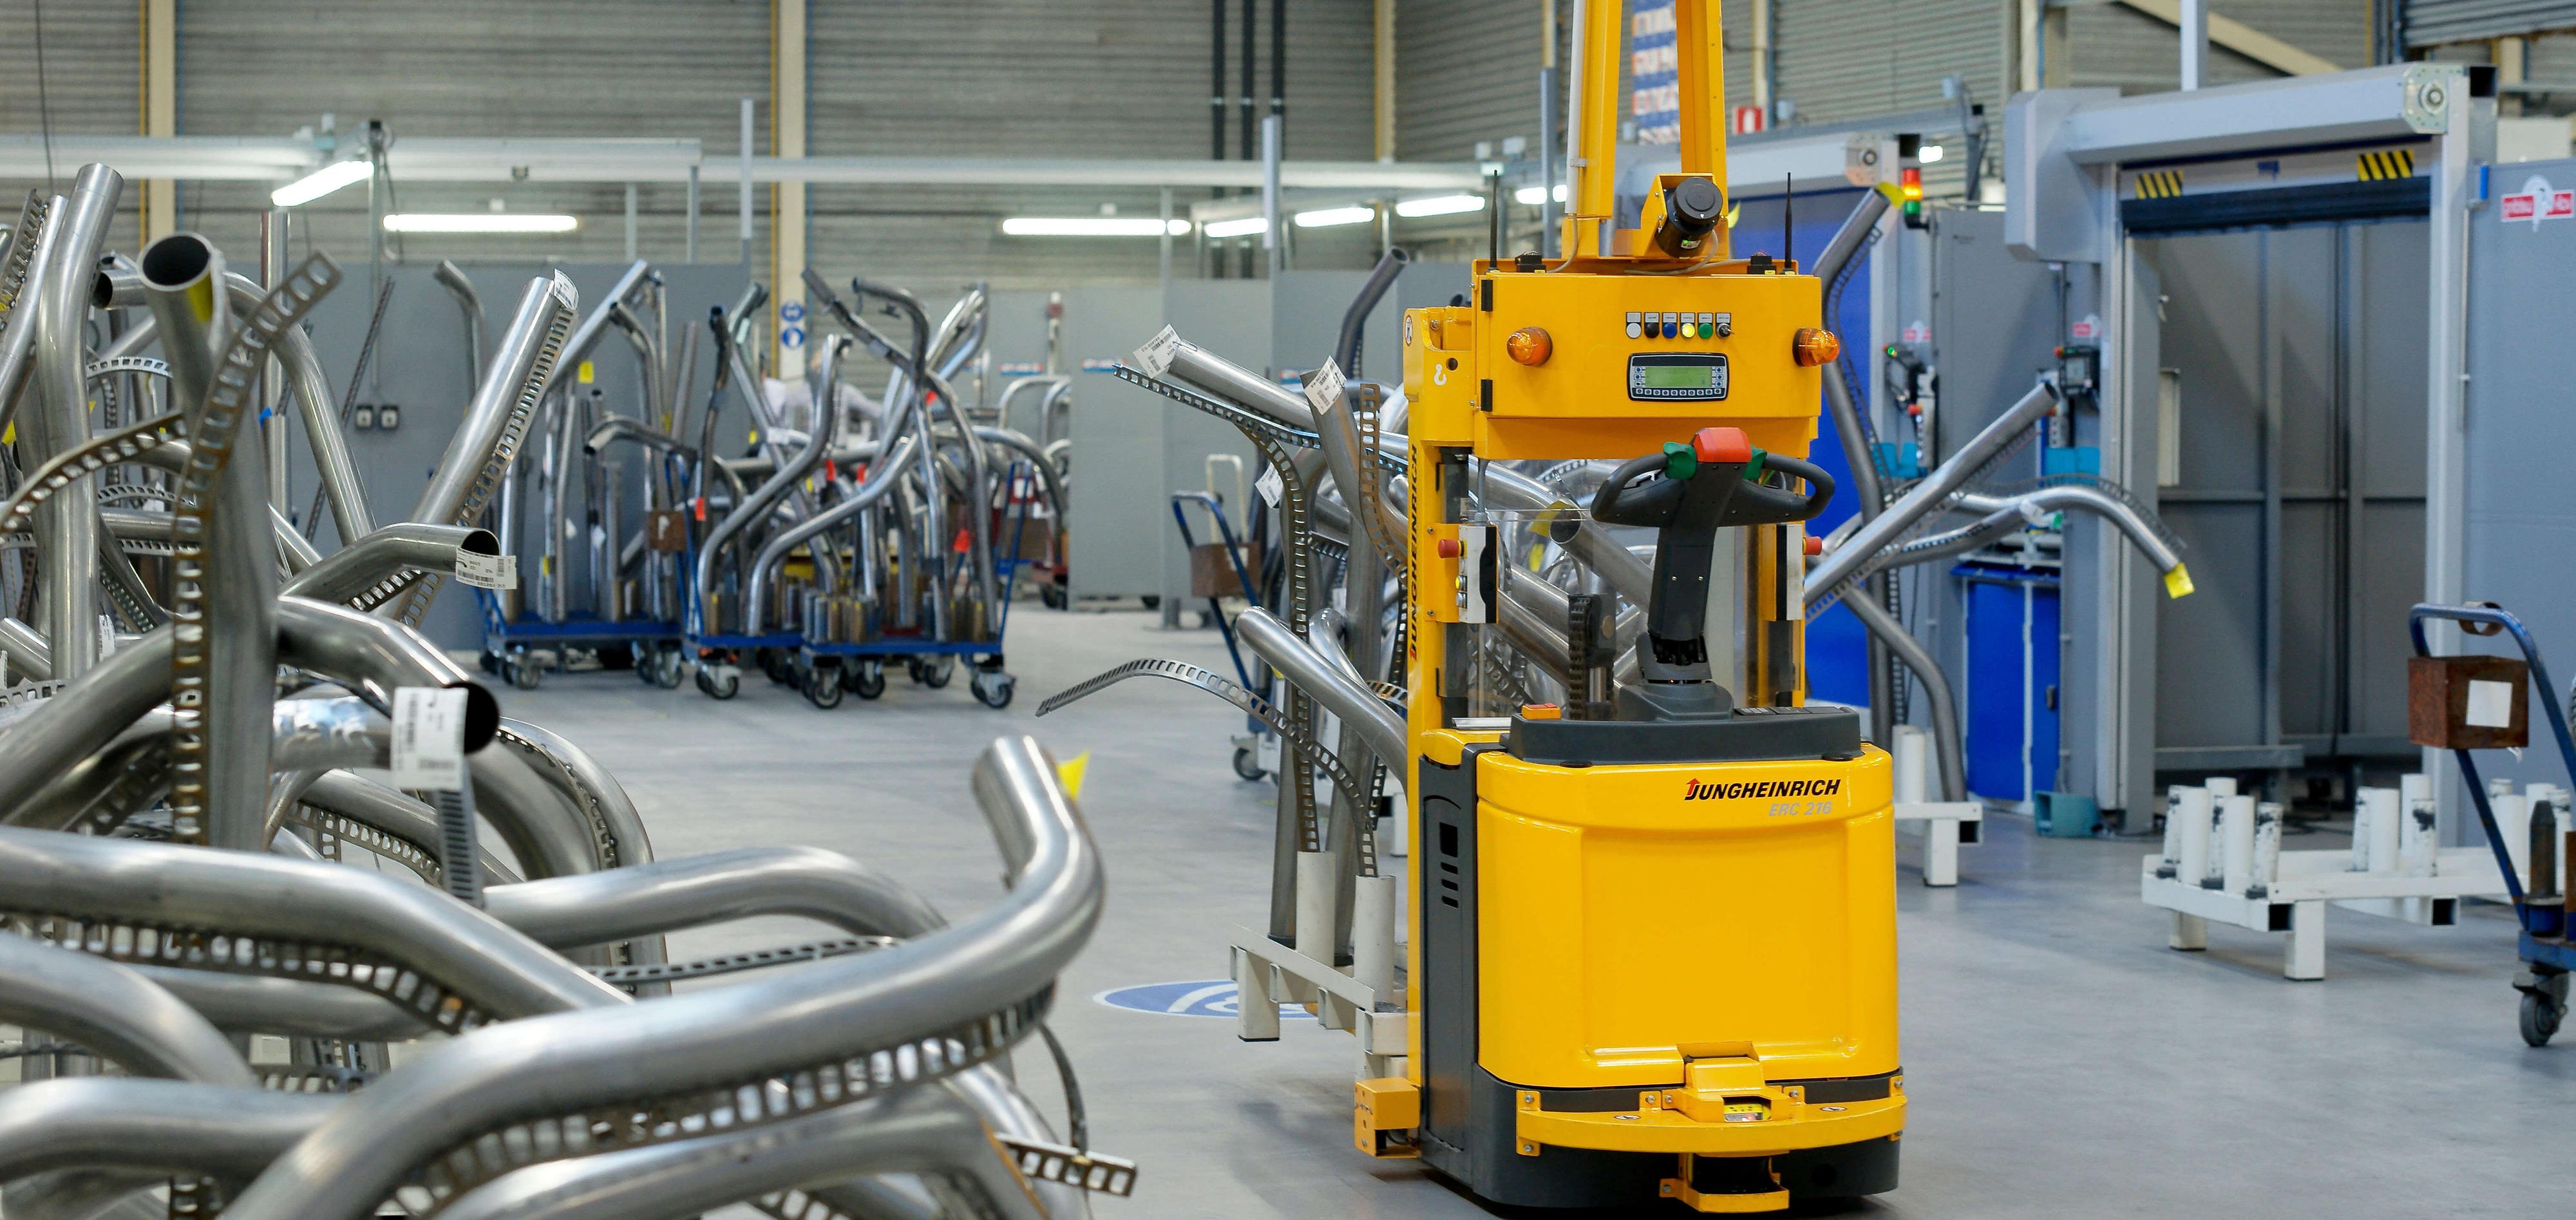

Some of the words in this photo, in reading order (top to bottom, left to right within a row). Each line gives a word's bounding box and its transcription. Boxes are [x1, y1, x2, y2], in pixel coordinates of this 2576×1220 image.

[1685, 778, 1841, 800] JUNGHEINRICH
[1768, 803, 1801, 816] ERC
[1804, 801, 1833, 815] 216
